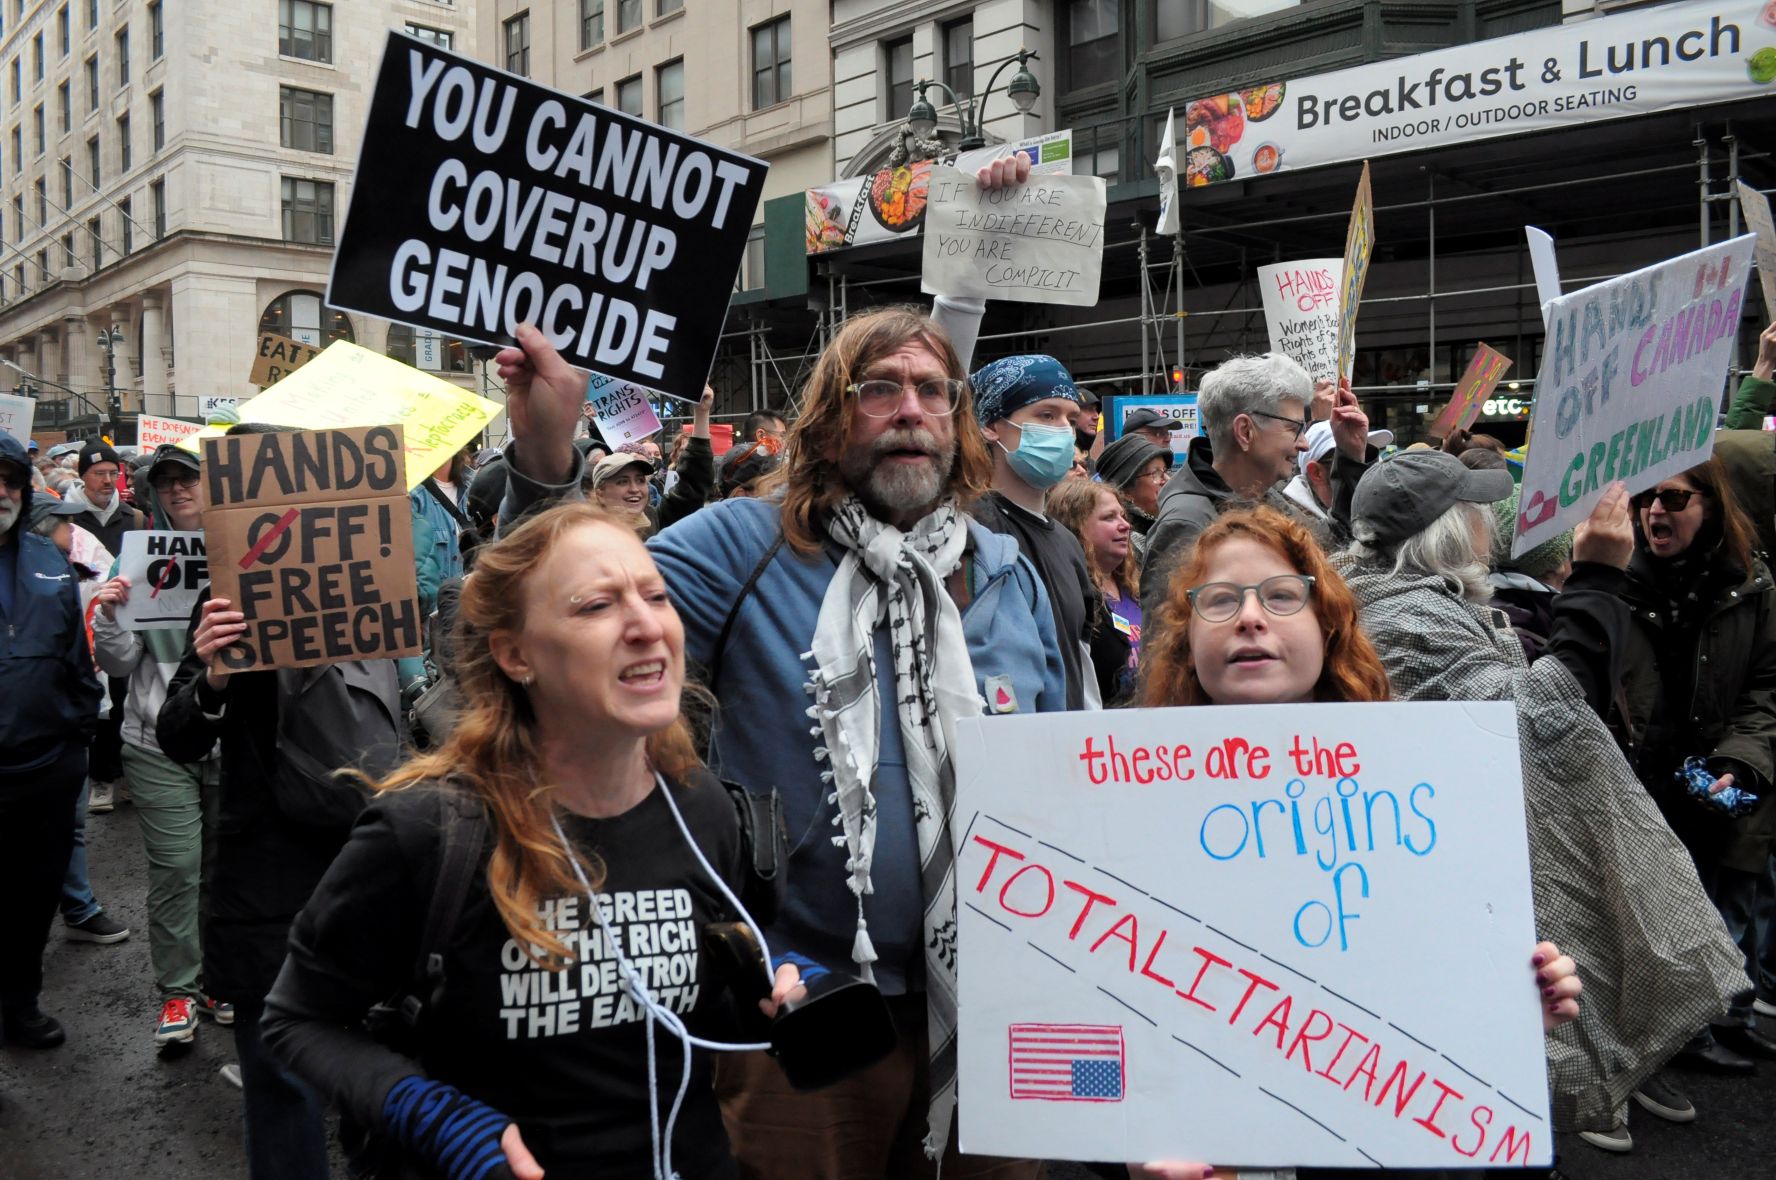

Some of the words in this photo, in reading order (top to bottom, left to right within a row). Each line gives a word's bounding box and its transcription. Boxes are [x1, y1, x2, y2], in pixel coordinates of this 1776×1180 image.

[1297, 58, 1525, 130] Breakfast
[1541, 58, 1562, 83] &
[1578, 16, 1741, 79] Lunch
[405, 49, 518, 154] YOU
[526, 100, 750, 229] CANNOT
[1372, 119, 1440, 143] INDOOR
[1456, 100, 1549, 129] OUTDOOR
[1554, 85, 1637, 114] SEATING
[844, 174, 876, 245] Breakfast
[935, 182, 969, 202] IF
[978, 187, 1019, 206] YOU
[1020, 187, 1065, 206] ARE
[428, 158, 678, 290] COVERUP
[937, 234, 971, 258] YOU
[974, 239, 1016, 260] ARE
[955, 210, 1104, 248] INDIFFERENT
[985, 264, 1080, 289] COMPICIT
[1275, 268, 1335, 301] HANDS
[1297, 292, 1334, 312] OFF
[389, 239, 677, 379] GENOCIDE
[1554, 271, 1664, 388] HANDS
[260, 337, 302, 364] EAT
[1279, 335, 1314, 352] Rights
[1631, 288, 1741, 387] CANADA
[593, 384, 635, 410] TRANS
[598, 394, 642, 421] RIGHTS
[1172, 408, 1197, 419] OFF
[1555, 346, 1619, 440] OFF
[142, 432, 167, 443] EVEN
[143, 419, 159, 430] HE
[206, 426, 399, 506] HANDS
[1559, 396, 1714, 508] GREENLAND
[246, 504, 392, 564] OFF!
[238, 560, 381, 621] FREE
[219, 599, 417, 670] SPEECH
[1080, 735, 1195, 785] these
[1205, 737, 1271, 779] are
[1289, 735, 1361, 778] the
[1199, 778, 1438, 872] origins
[530, 897, 579, 931] HE
[590, 888, 693, 926] GREED
[557, 926, 623, 964] THE
[629, 920, 697, 956] RICH
[500, 969, 577, 1006] WILL
[581, 952, 698, 997] DESTROY
[972, 834, 1533, 1167] TOTALITARIANISM
[500, 1001, 580, 1039] THE
